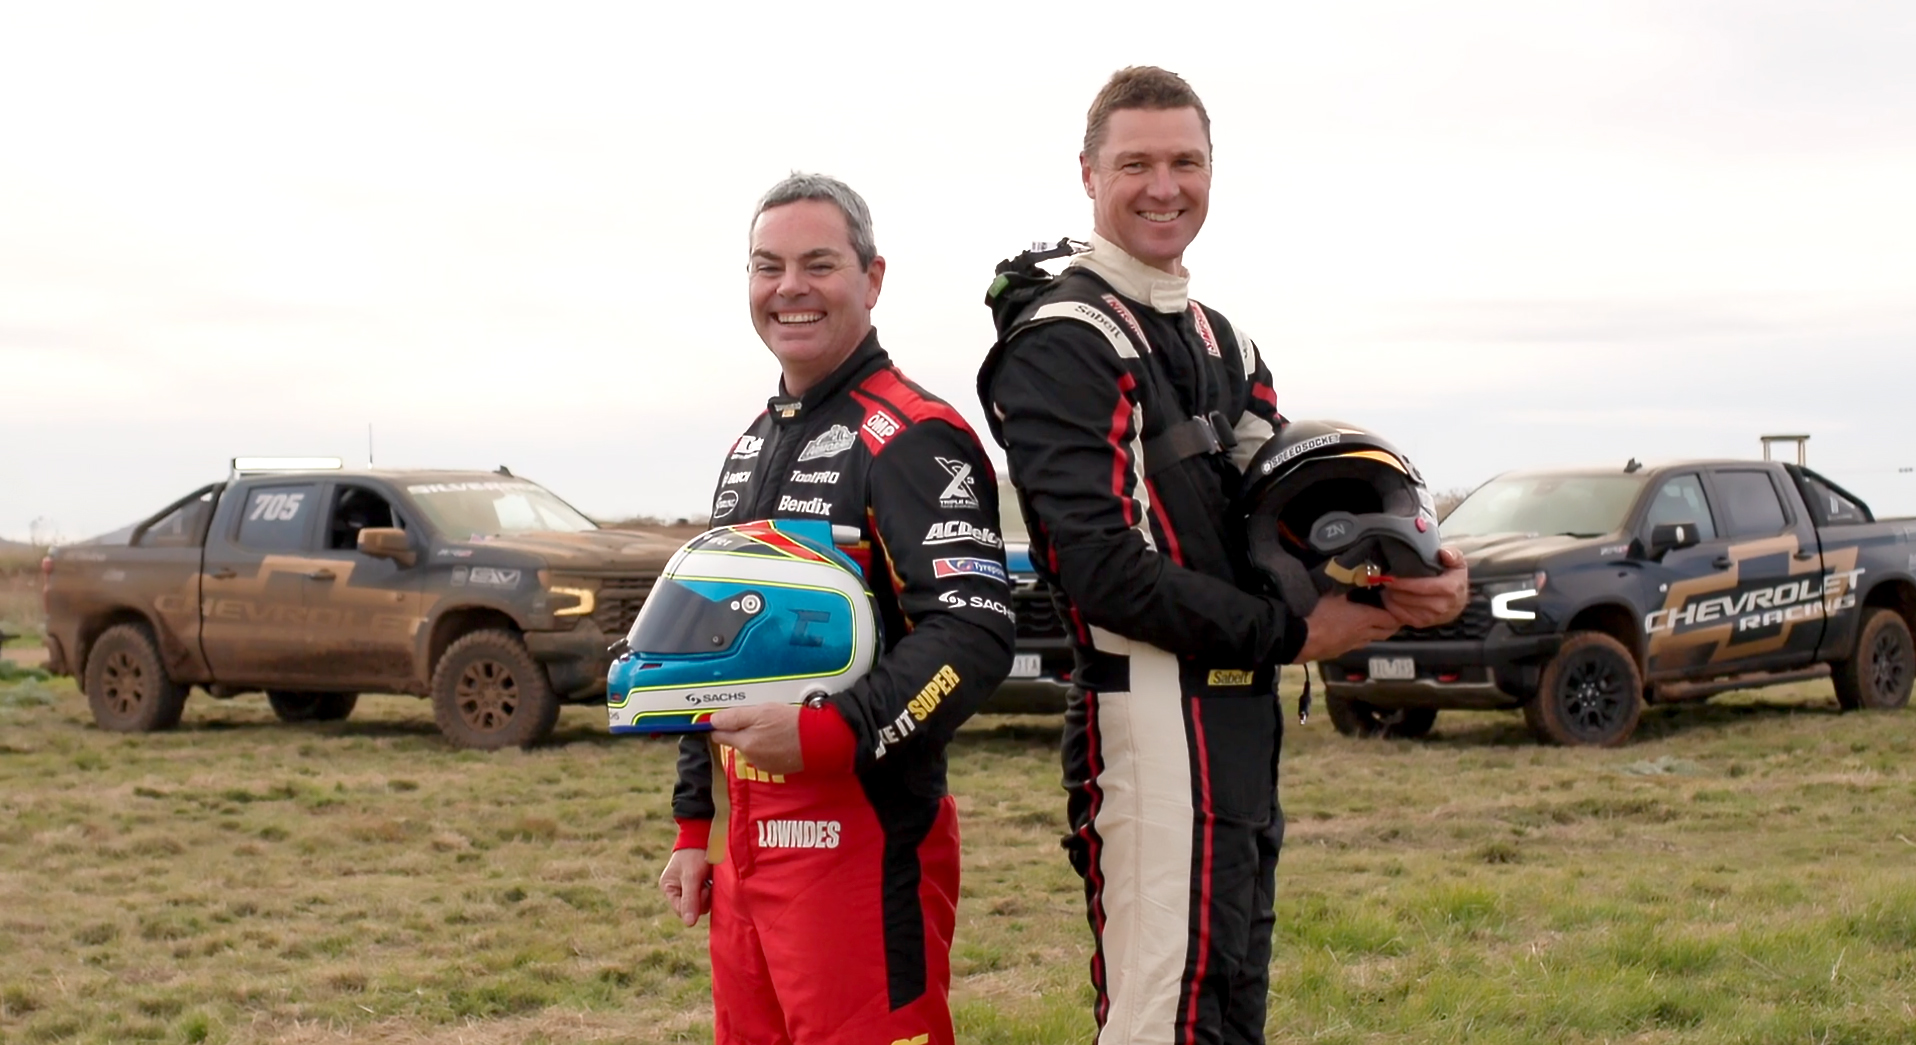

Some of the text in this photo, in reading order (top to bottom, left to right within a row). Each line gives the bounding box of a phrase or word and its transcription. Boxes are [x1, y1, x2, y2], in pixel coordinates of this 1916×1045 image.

[1074, 305, 1120, 339] Sabelt
[866, 413, 896, 437] OMP
[249, 494, 304, 521] 705
[778, 495, 833, 516] Bendix
[1644, 567, 1866, 634] CHEVROLET
[1739, 593, 1856, 631] RACING
[703, 692, 747, 702] SACHS
[894, 708, 916, 737] IT
[907, 664, 961, 721] SUPER
[757, 820, 841, 849] LOWNDES
